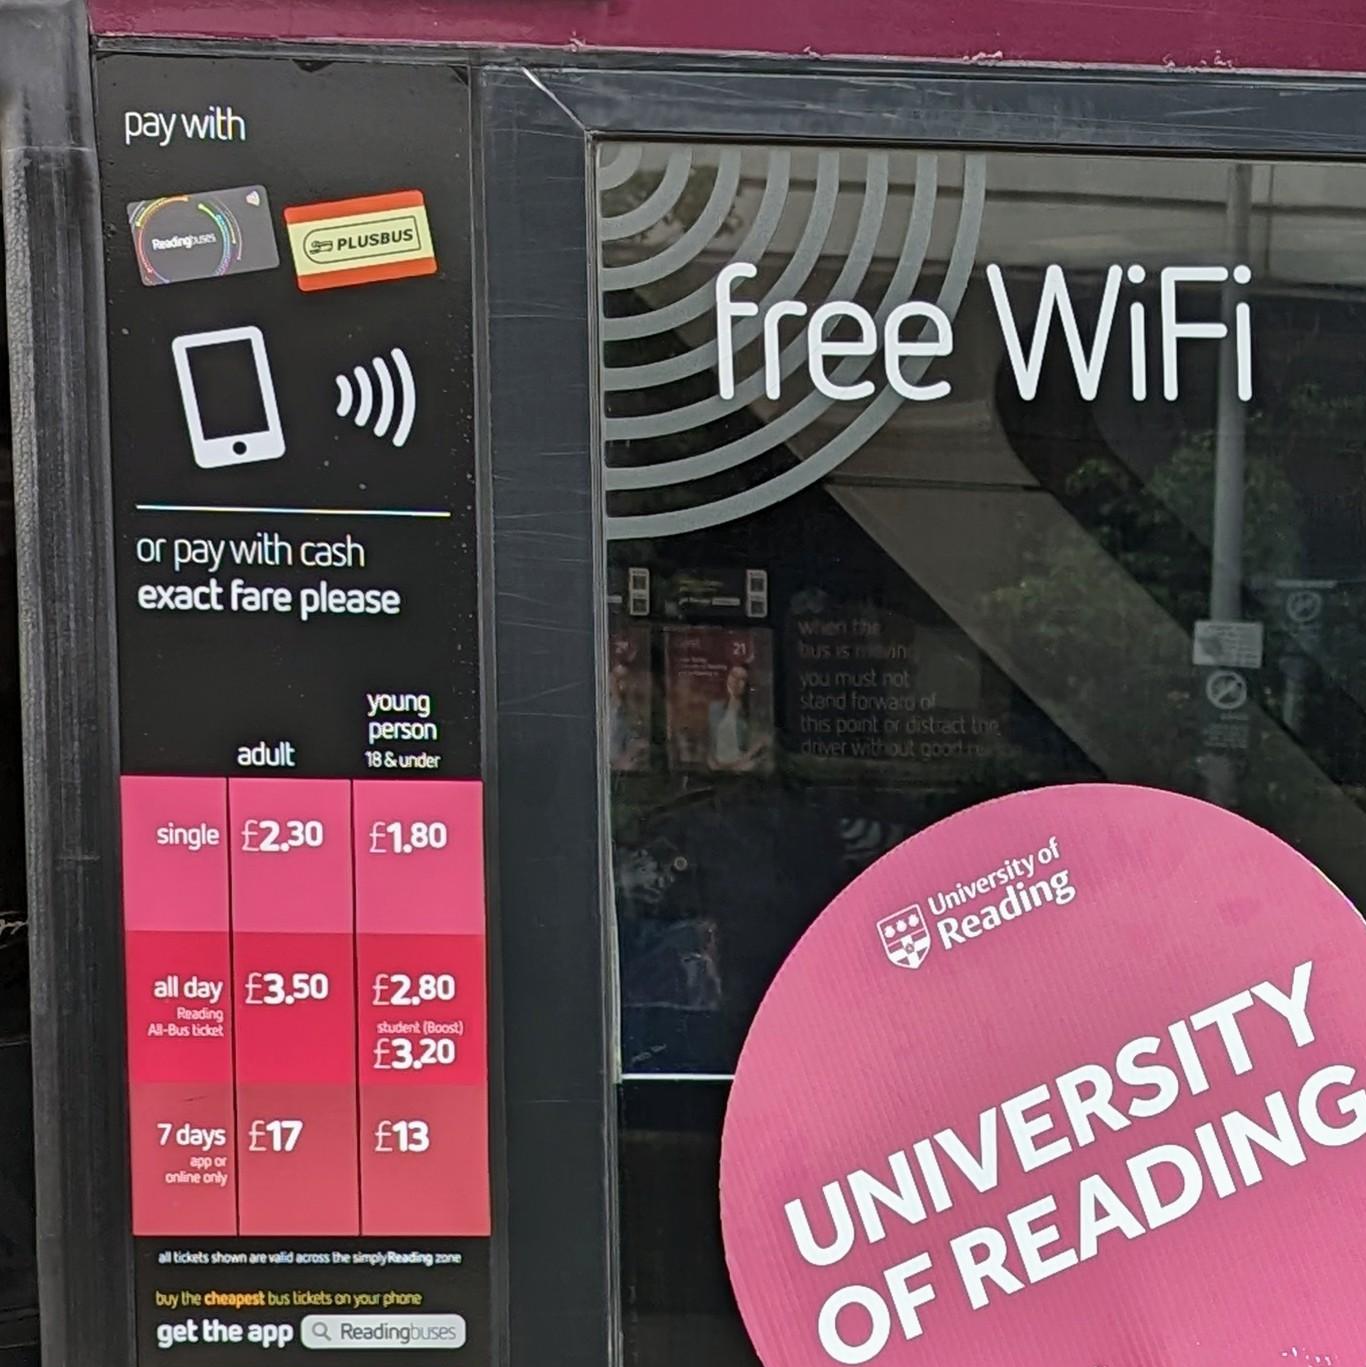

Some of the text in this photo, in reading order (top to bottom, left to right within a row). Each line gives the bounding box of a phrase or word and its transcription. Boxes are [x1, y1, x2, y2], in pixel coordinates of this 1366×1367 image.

[125, 106, 246, 146] pay with
[152, 233, 216, 250] Readingbuses
[336, 228, 414, 251] PLUSBUS
[716, 262, 1253, 401] free WiFi
[136, 532, 365, 572] or pay with cash
[138, 578, 400, 620] exact fare please
[800, 669, 911, 689] you must not
[367, 692, 430, 717] young
[800, 692, 847, 711] stand
[920, 692, 937, 710] of
[368, 719, 437, 744] person
[800, 715, 831, 732] this
[836, 715, 879, 736] point
[237, 742, 296, 767] adult
[365, 751, 384, 768] 18
[399, 751, 441, 769] under
[801, 740, 847, 755] driver
[156, 822, 220, 851] single
[241, 819, 324, 853] £2.30
[369, 821, 448, 854] £1.80
[928, 836, 1060, 915] University of
[937, 870, 1076, 950] Reading
[153, 976, 223, 1003] all day
[245, 972, 329, 1005] £3.50
[372, 973, 456, 1006] £2.80
[177, 1007, 223, 1023] Reading
[377, 1020, 464, 1036] student (Boost)
[148, 1023, 224, 1038] All-Bus ticket
[373, 1038, 456, 1071] £3.20
[784, 960, 1314, 1266] UNIVERSITY
[157, 1123, 226, 1151] 7 days
[248, 1120, 303, 1153] £17
[374, 1120, 430, 1153] £13
[190, 1156, 228, 1169] app or
[165, 1171, 228, 1186] online only
[159, 1252, 461, 1266] all tickets shown are valid across the simplyReading zone
[156, 1291, 422, 1308] buy the cheapest bus tickets on your phone
[817, 1252, 935, 1365] OF
[157, 1318, 293, 1348] get the app
[340, 1322, 457, 1344] Readingbuses
